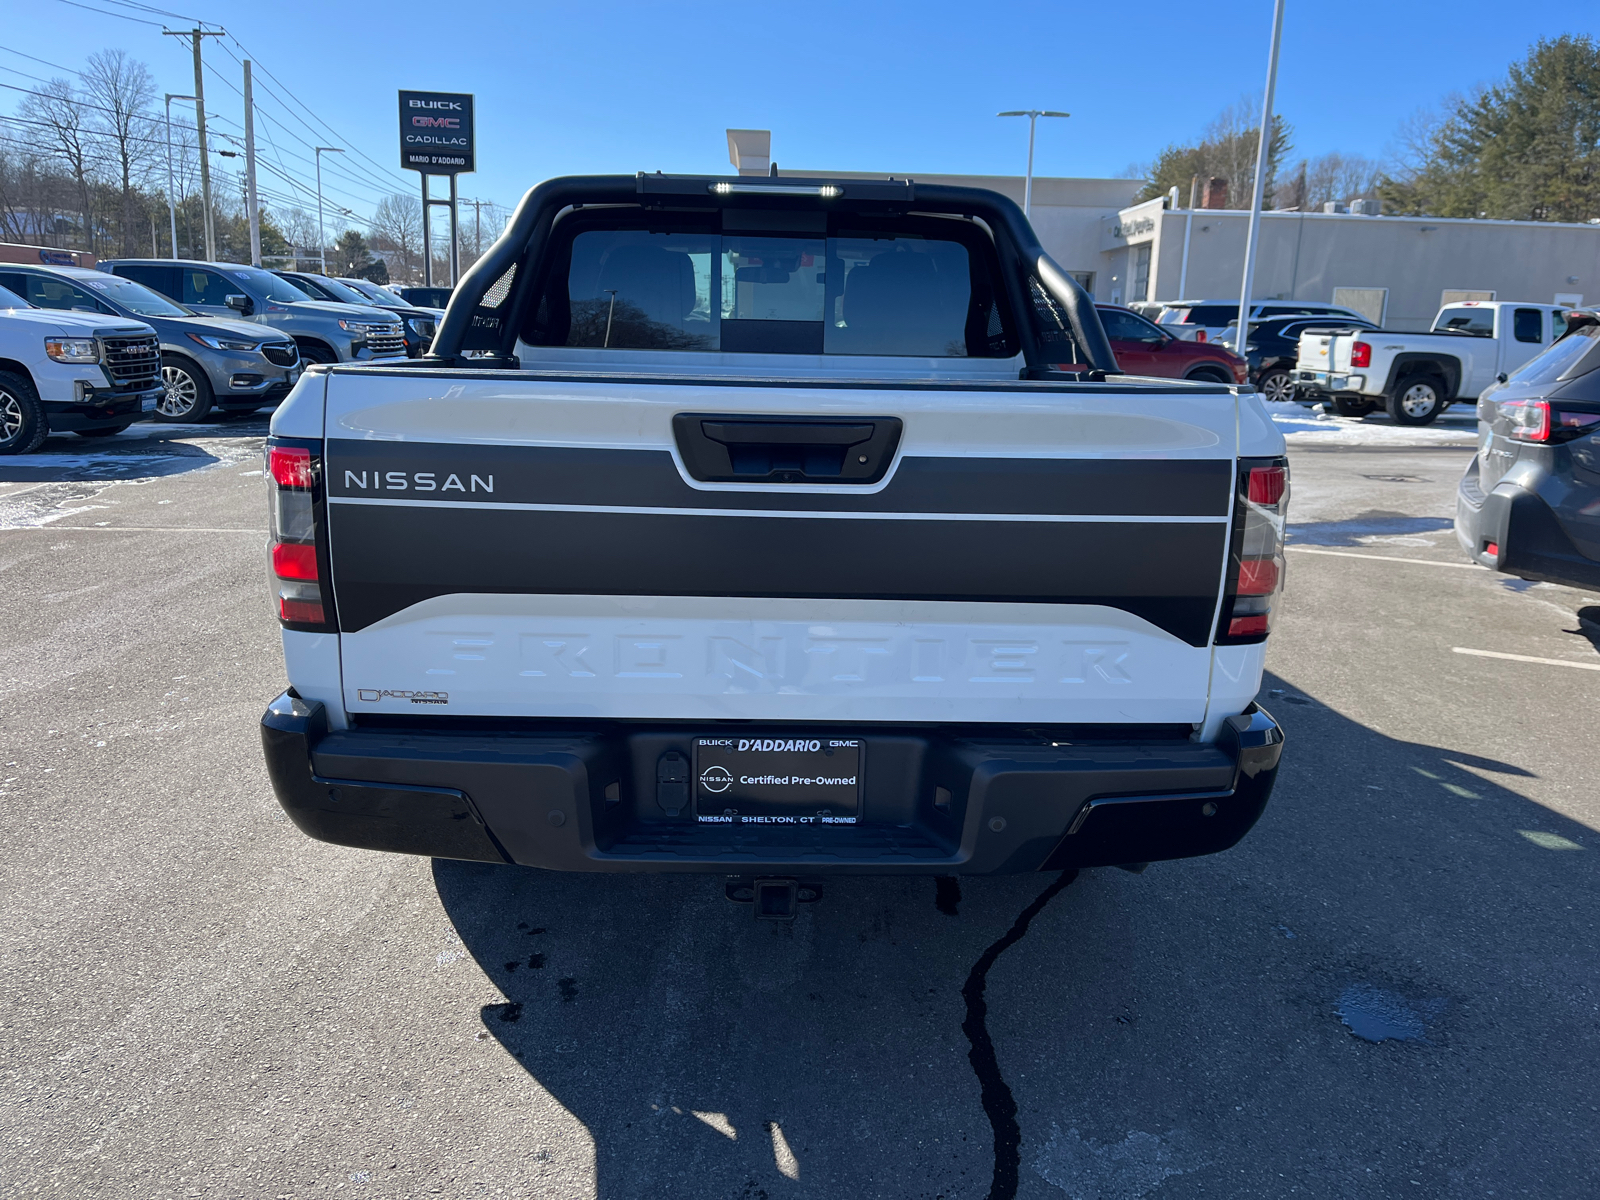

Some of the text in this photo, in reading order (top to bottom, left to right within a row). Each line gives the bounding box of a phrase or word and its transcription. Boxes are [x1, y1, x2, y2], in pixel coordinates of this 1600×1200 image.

[409, 100, 462, 110] BUICK
[413, 116, 460, 128] GMC
[406, 135, 467, 145] CADILLAC
[409, 155, 465, 165] MARIO D'ADDARIO
[344, 470, 494, 493] NISSAN
[424, 631, 1132, 684] FRONTIER
[737, 739, 821, 752] D'ADDARIO
[739, 775, 856, 785] Certified Pre-Owned
[741, 816, 797, 824] SHELTON,
